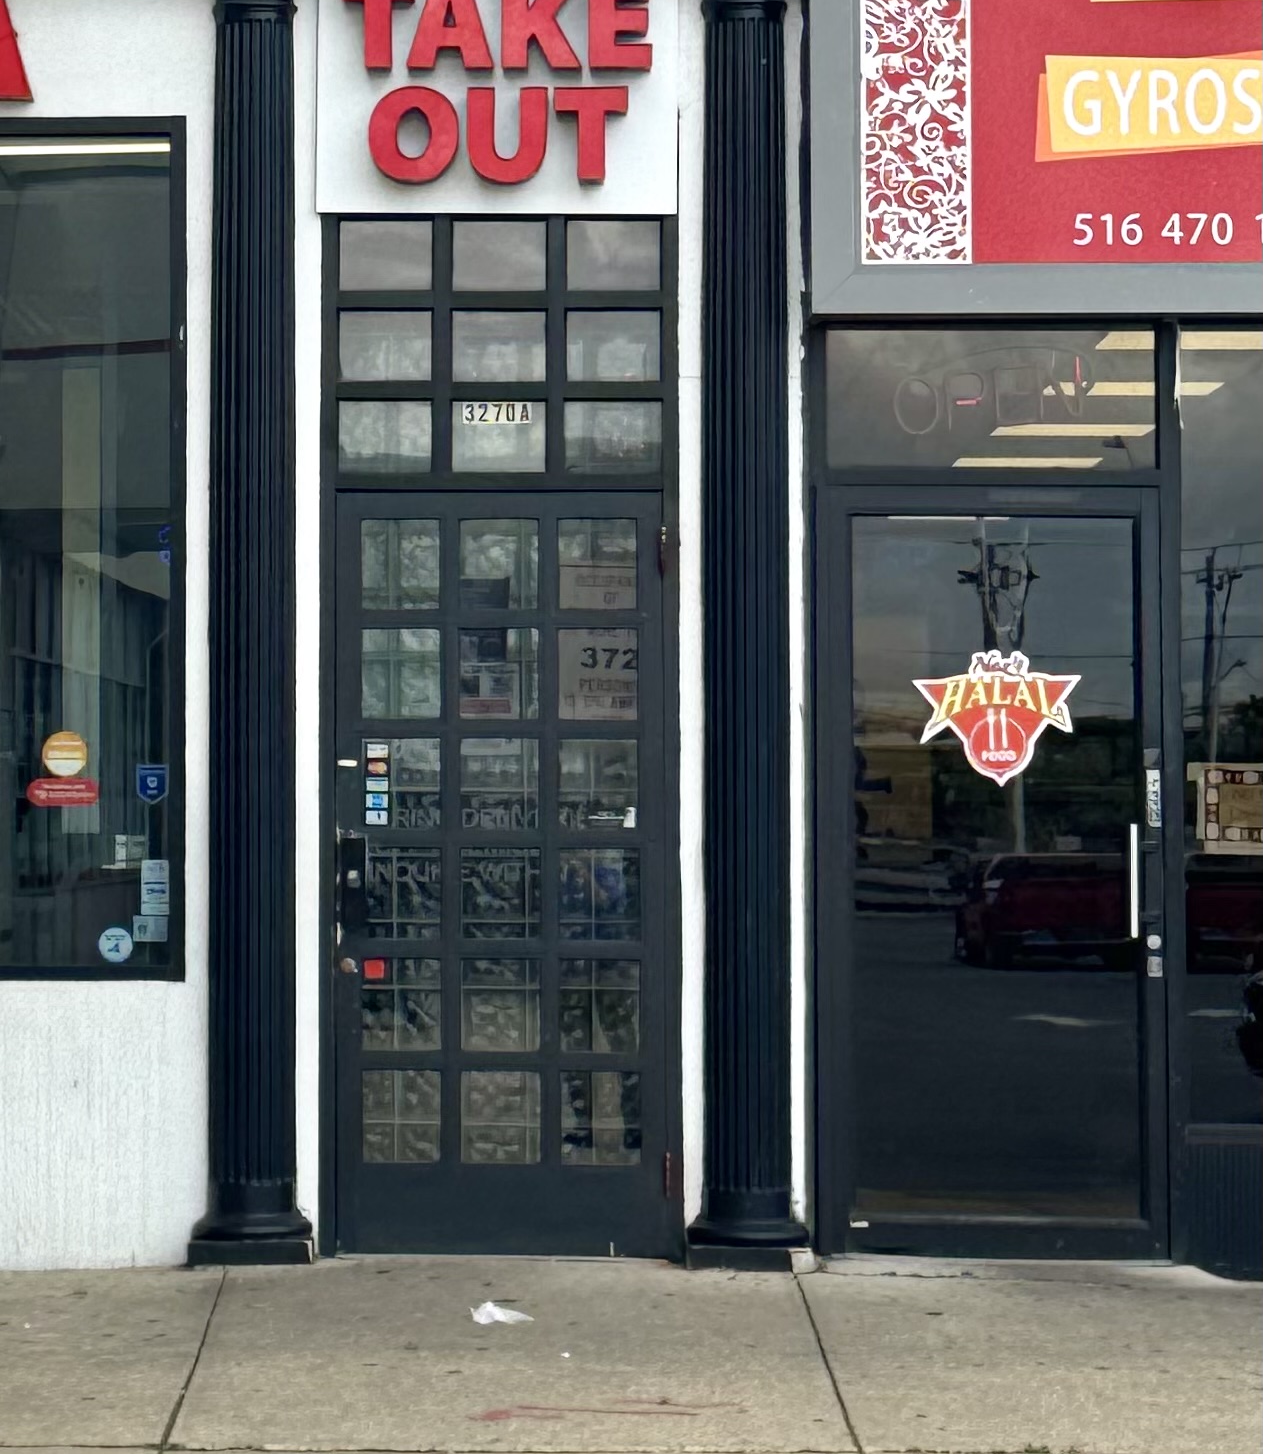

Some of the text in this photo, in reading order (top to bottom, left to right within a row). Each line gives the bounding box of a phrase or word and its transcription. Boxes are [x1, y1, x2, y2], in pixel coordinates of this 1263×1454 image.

[1062, 67, 1263, 136] GYROS
[366, 84, 630, 187] OUT
[1072, 211, 1144, 247] 516
[1160, 211, 1235, 247] 470
[464, 403, 531, 424] 3270A
[579, 646, 638, 671] 372
[933, 675, 1069, 728] HALAL
